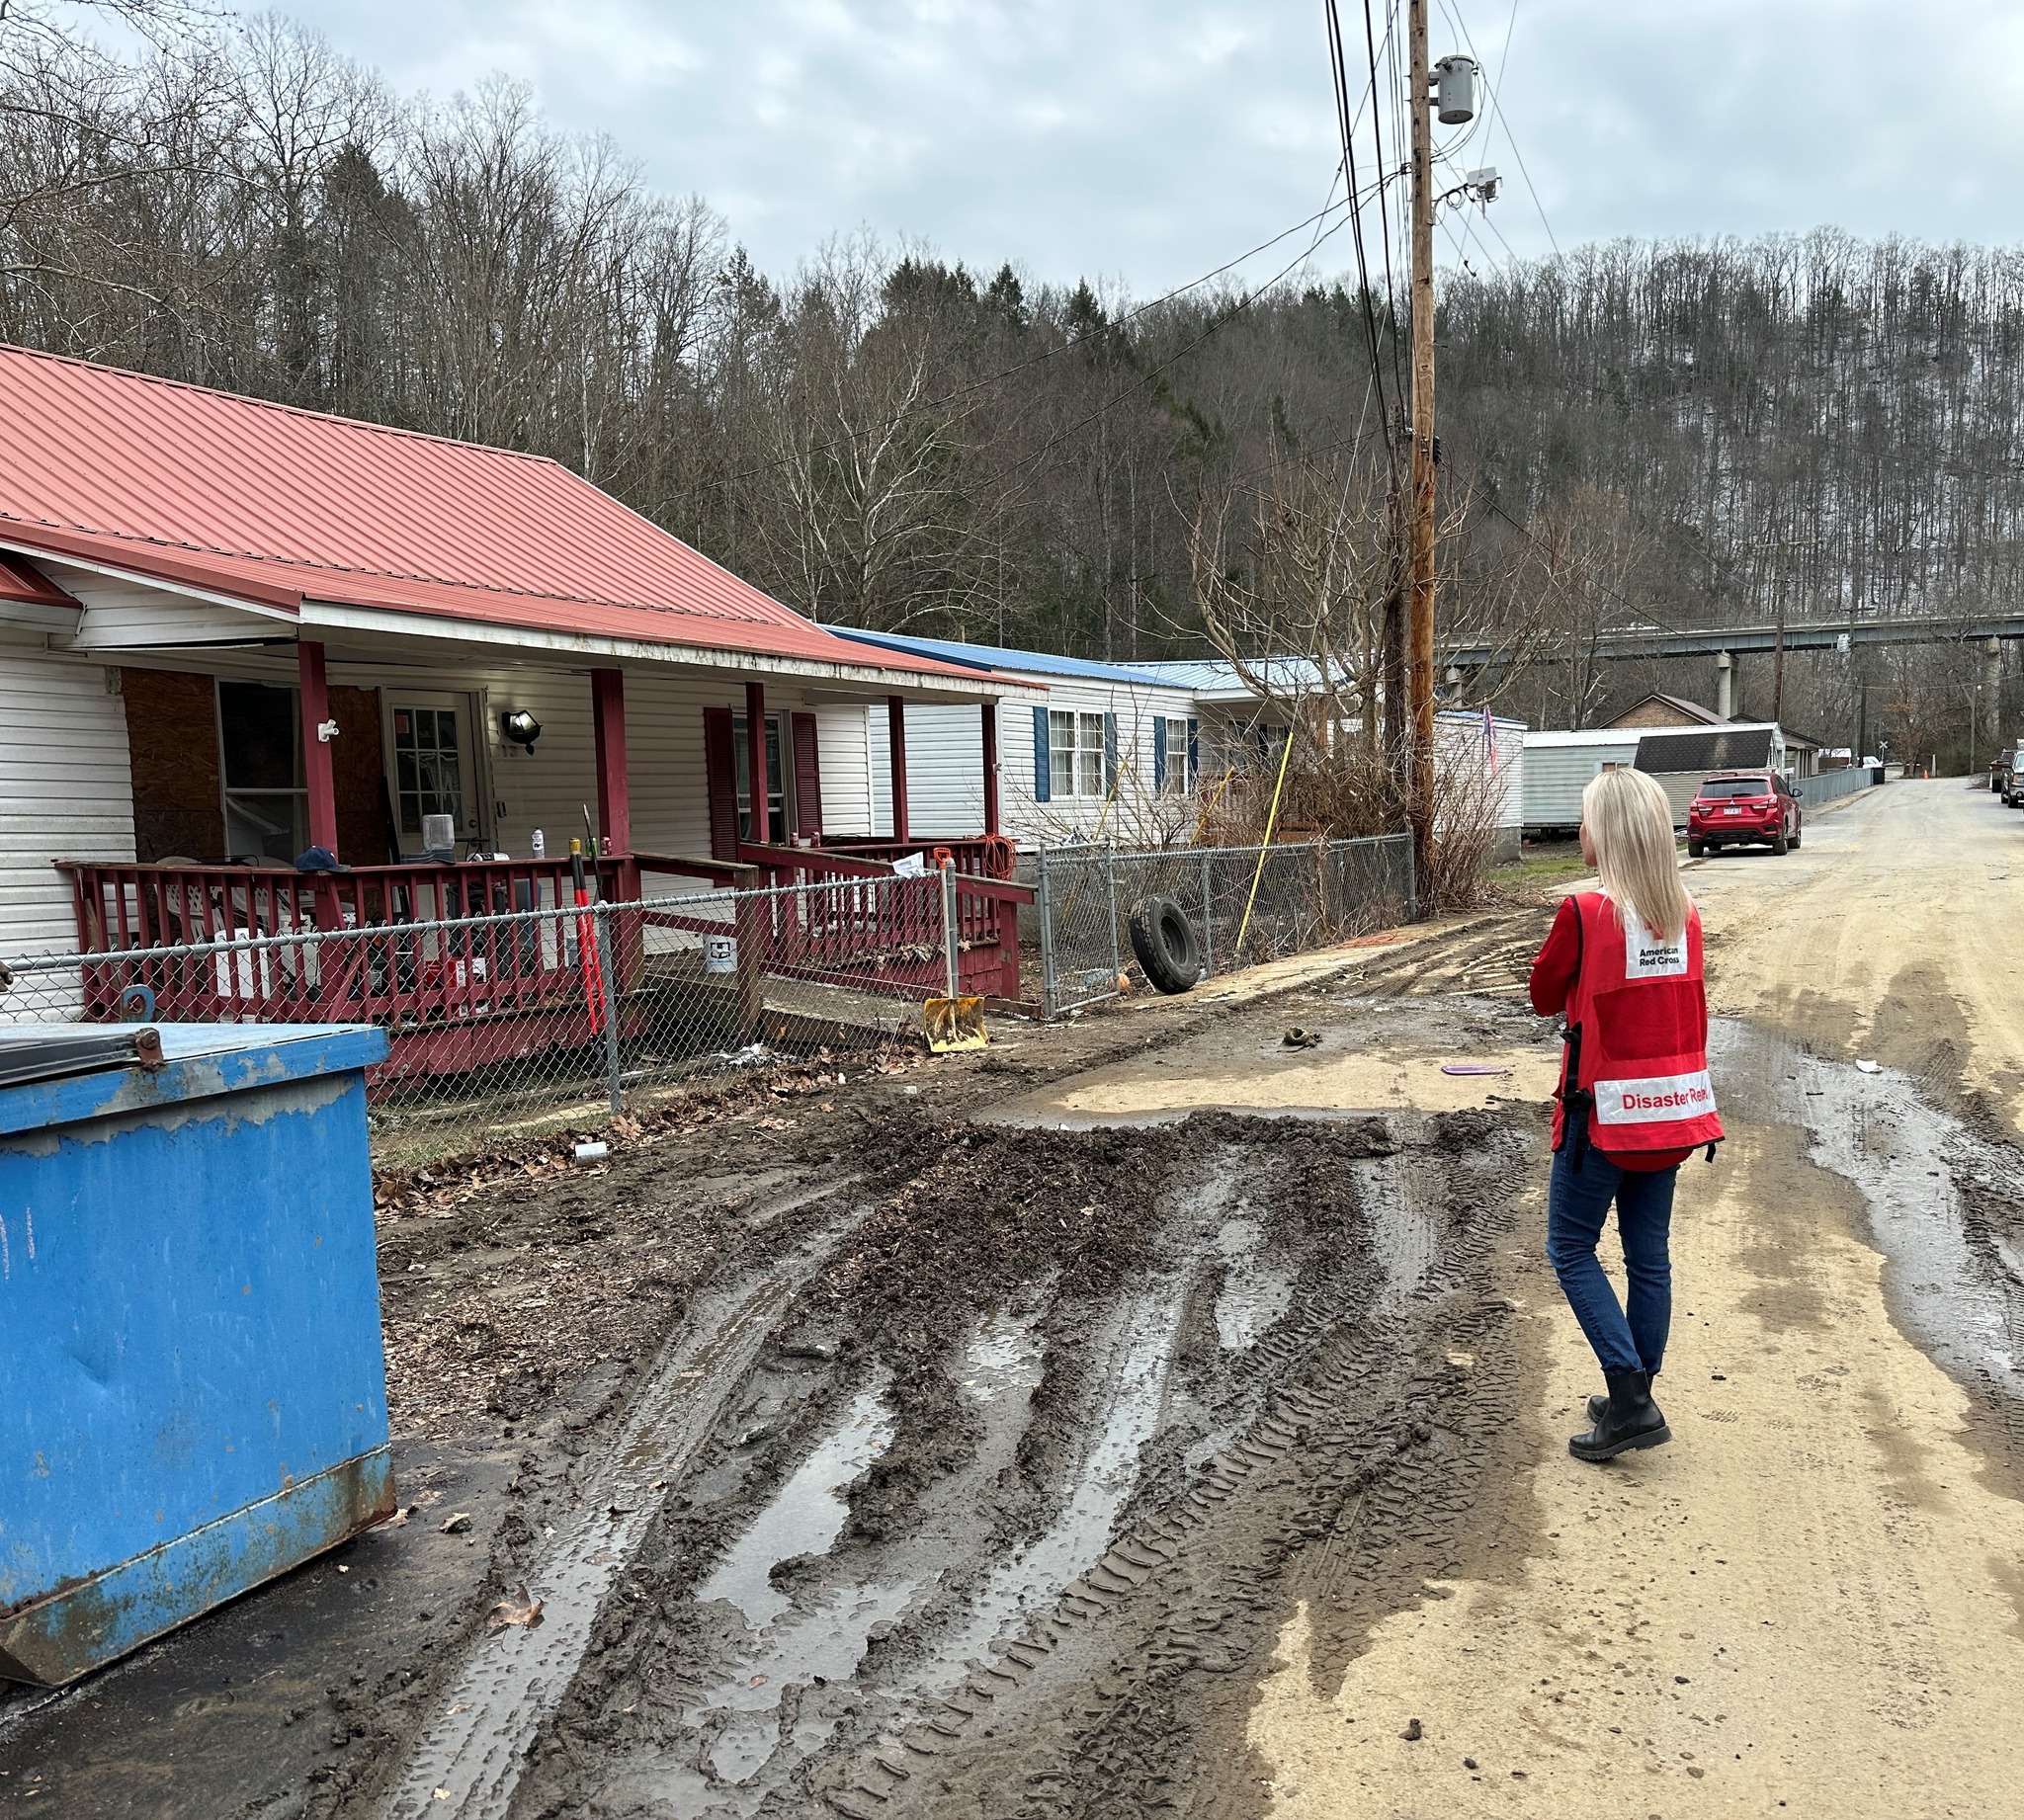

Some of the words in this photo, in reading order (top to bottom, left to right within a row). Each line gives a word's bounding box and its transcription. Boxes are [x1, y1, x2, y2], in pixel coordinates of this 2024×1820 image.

[1640, 947, 1679, 957] American
[1640, 957, 1655, 966] Red
[1657, 956, 1680, 965] Cross
[1622, 1091, 1688, 1110] Disaster
